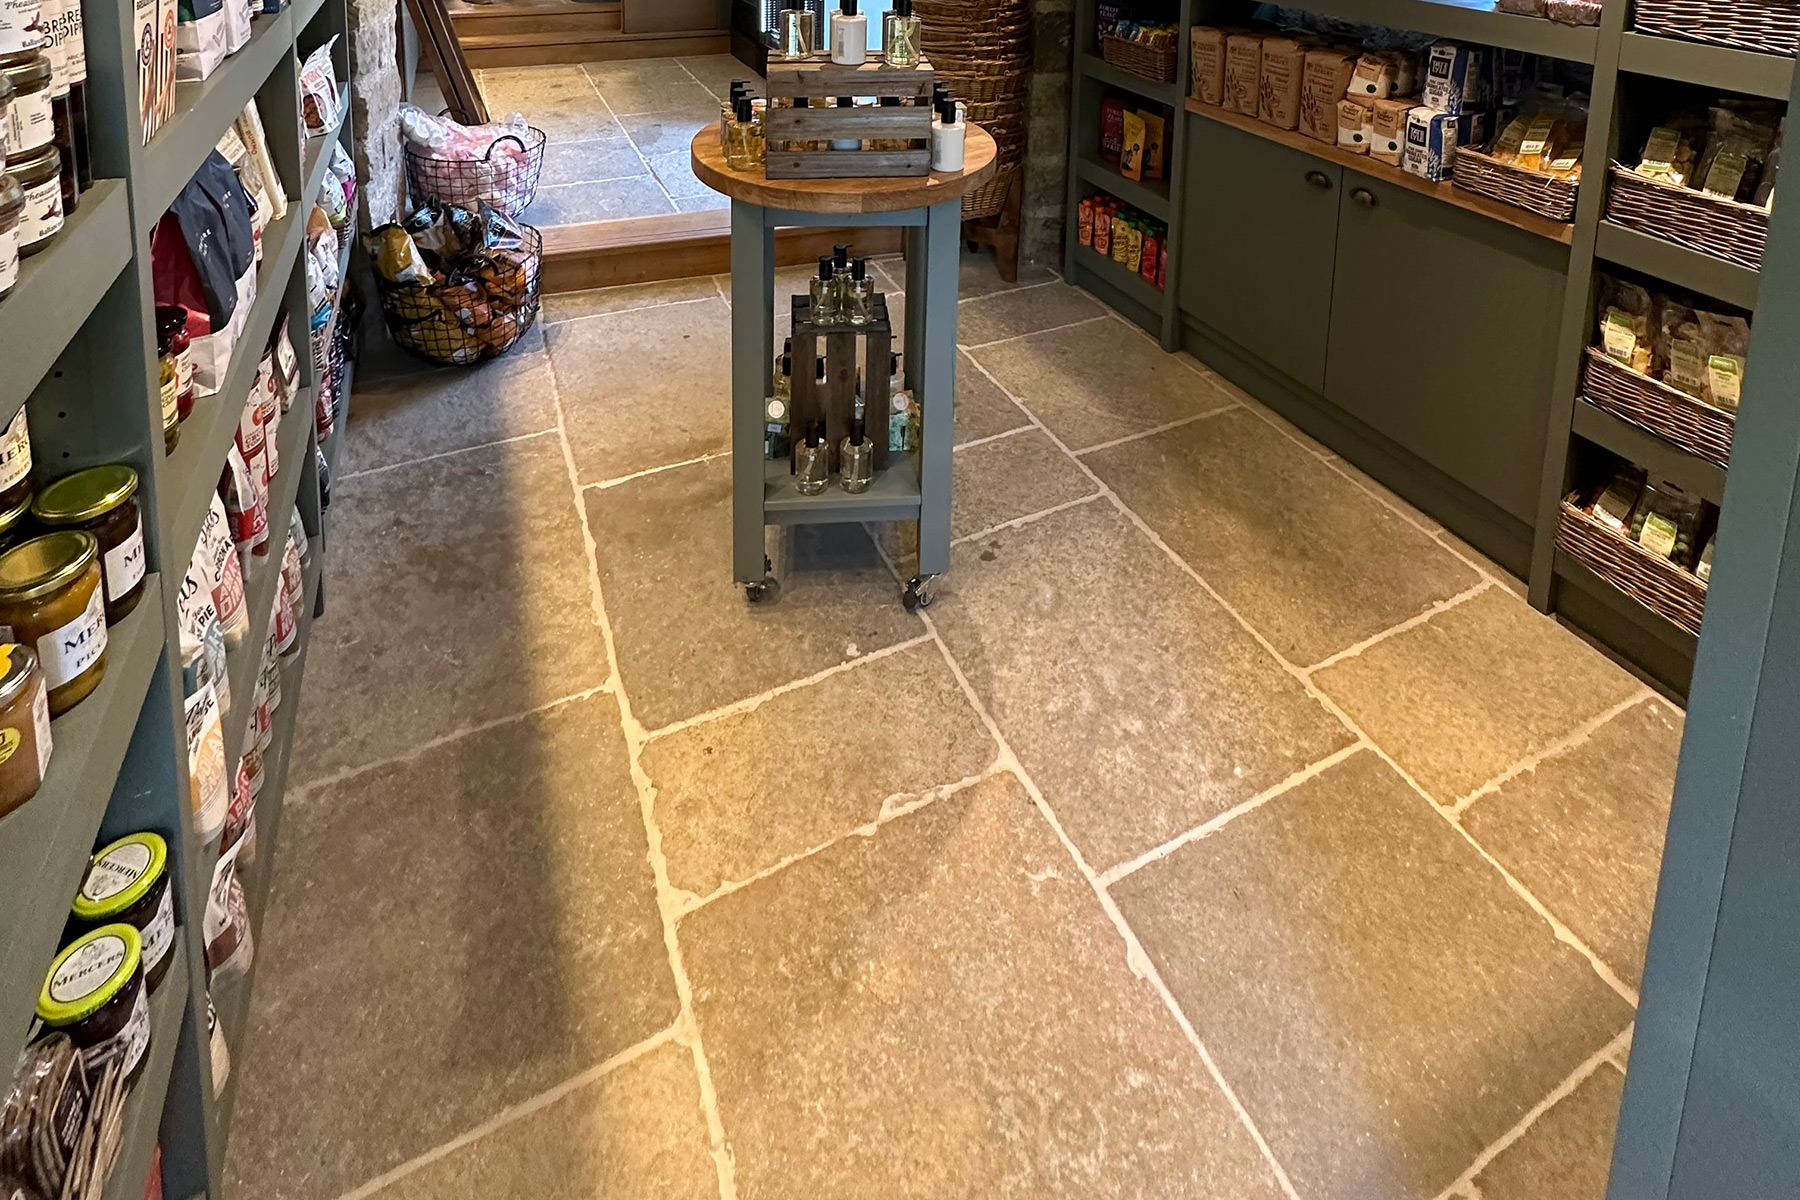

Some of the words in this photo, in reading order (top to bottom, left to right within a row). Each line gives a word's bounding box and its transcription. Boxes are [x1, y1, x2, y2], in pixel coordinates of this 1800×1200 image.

[198, 605, 215, 625] PIE
[98, 859, 140, 880] MERCERS
[53, 951, 124, 988] MERCERS
